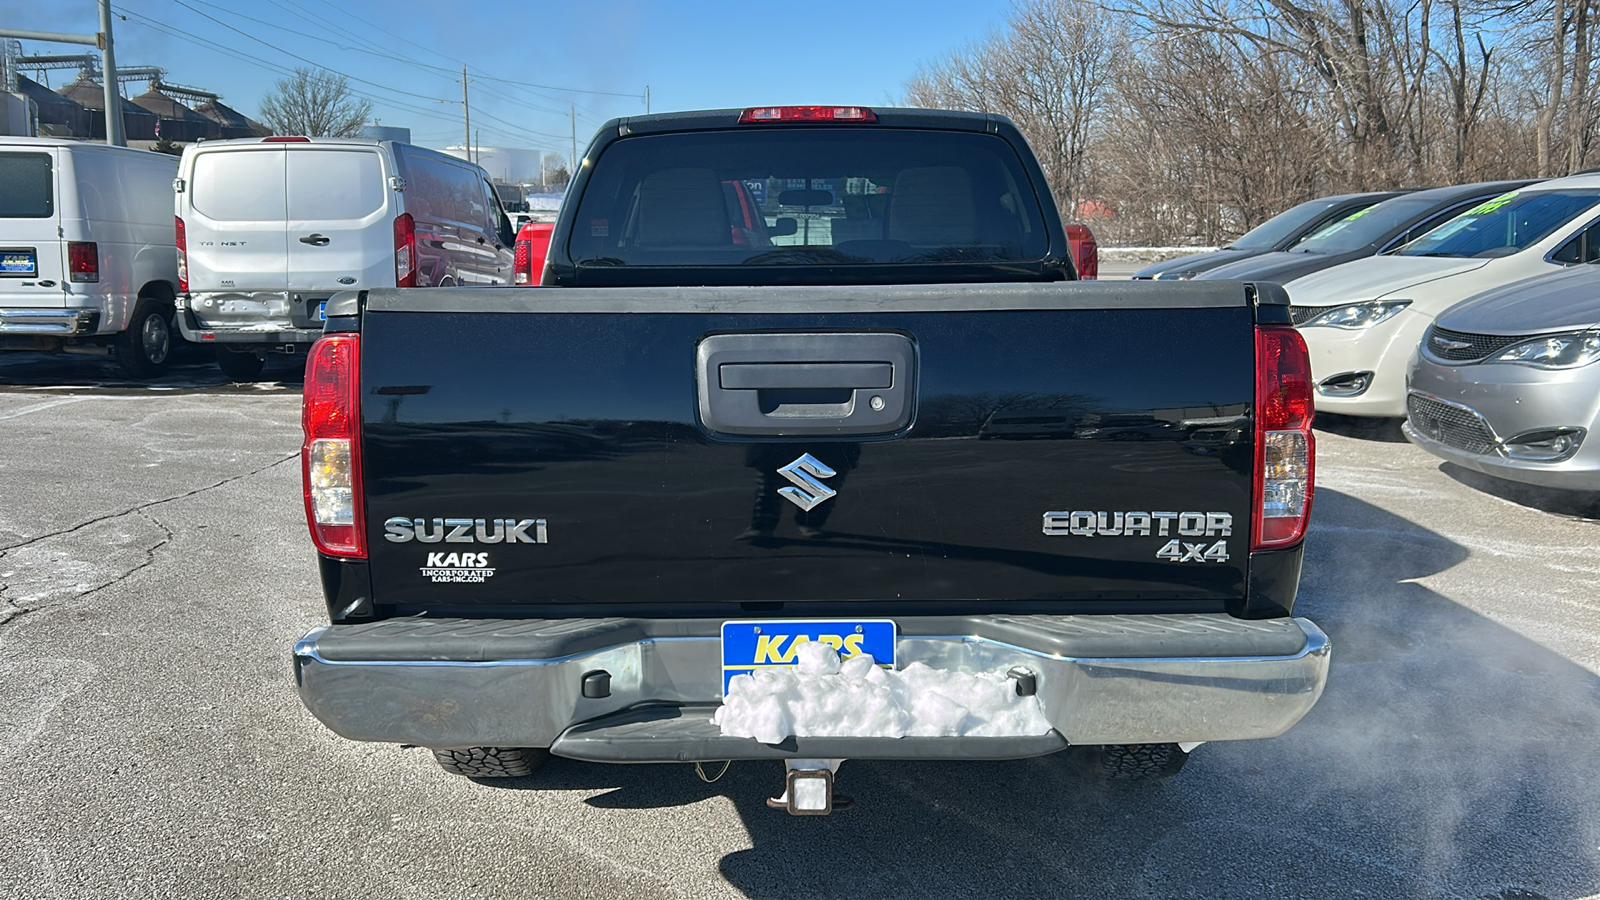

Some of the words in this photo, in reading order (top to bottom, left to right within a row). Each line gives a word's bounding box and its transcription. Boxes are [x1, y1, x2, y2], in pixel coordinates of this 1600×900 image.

[384, 516, 548, 544] SUZUKI
[1042, 511, 1233, 537] EQUATOR
[427, 552, 488, 567] KARS
